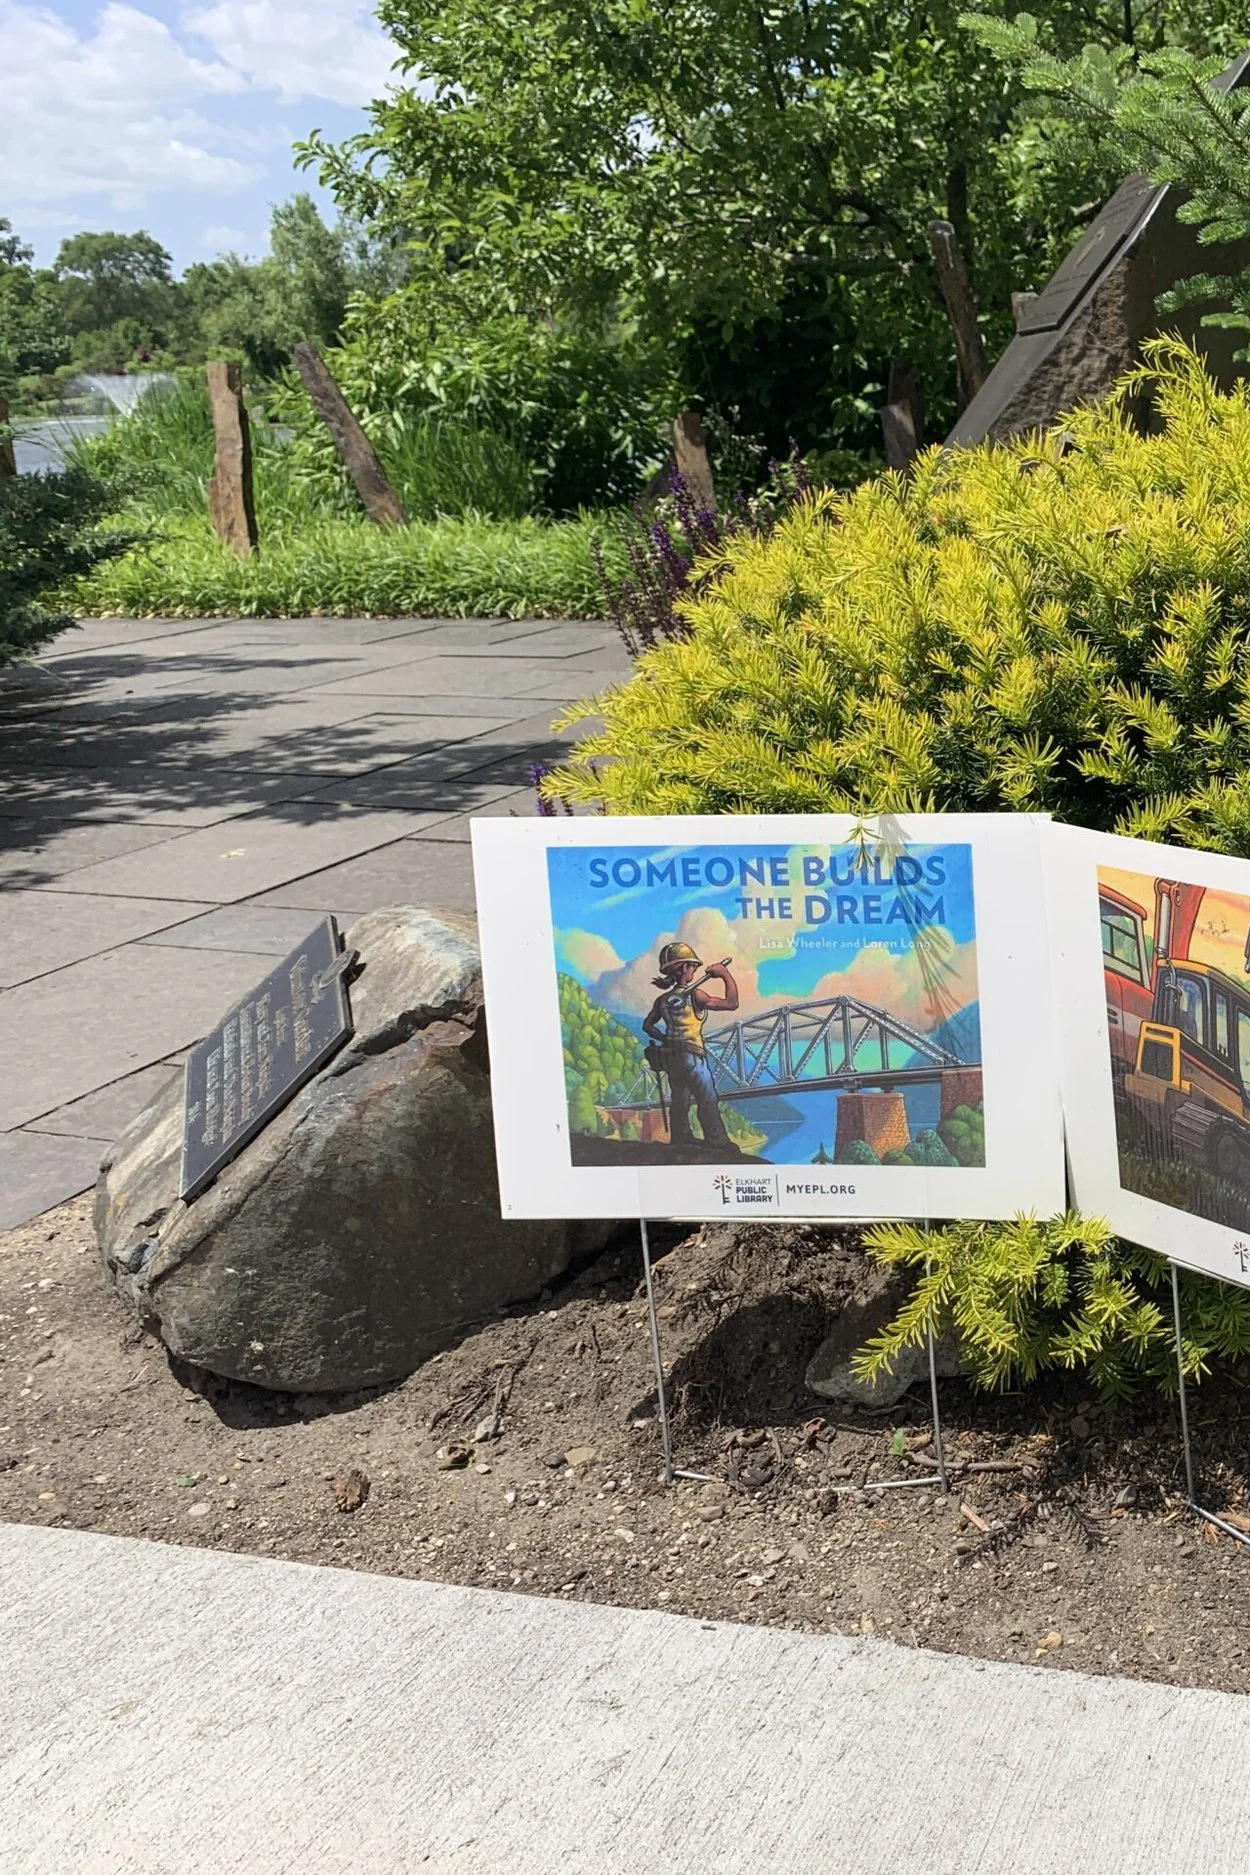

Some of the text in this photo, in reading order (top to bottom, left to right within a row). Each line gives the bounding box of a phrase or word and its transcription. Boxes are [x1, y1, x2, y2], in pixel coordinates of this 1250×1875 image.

[589, 855, 946, 888] SOMEONE BUILDS
[736, 894, 946, 925] THE DREAM
[759, 937, 931, 952] Lisa Wheeler and Loren Long
[736, 1178, 771, 1186] ELKHART
[736, 1186, 767, 1194] PUBLIC
[786, 1184, 856, 1194] MYEPL.ORG
[737, 1195, 773, 1203] LIBRARY
